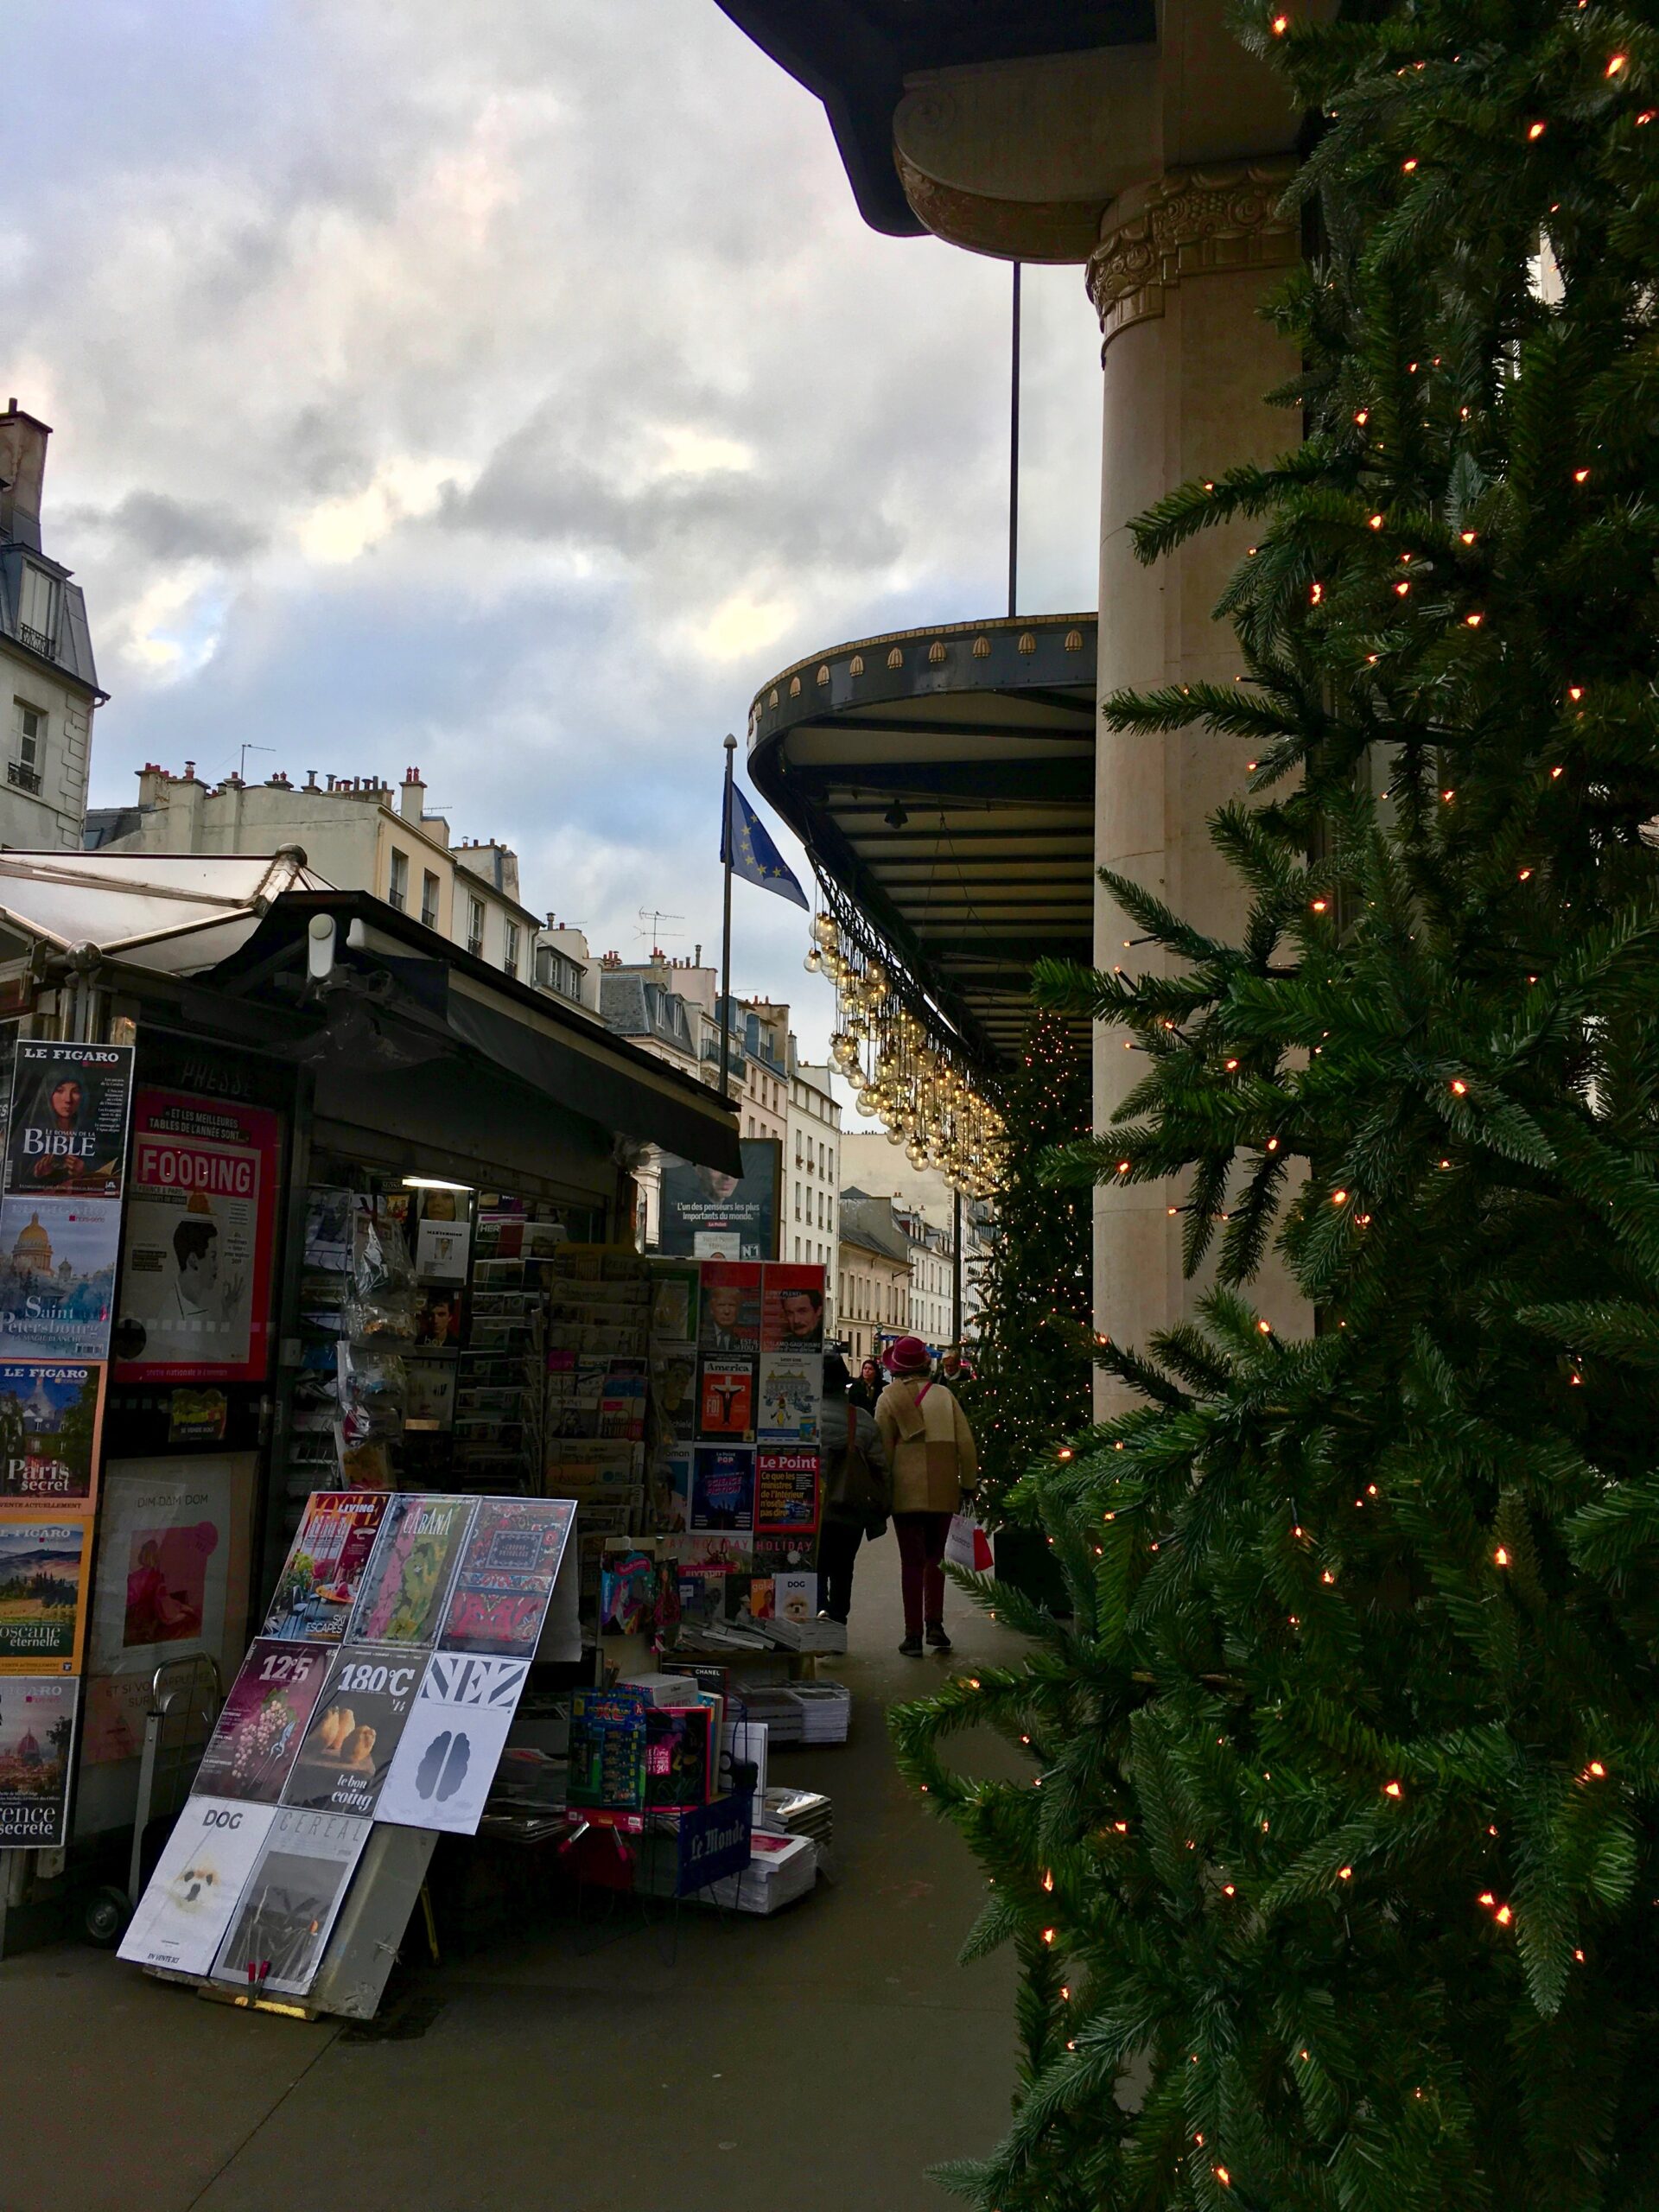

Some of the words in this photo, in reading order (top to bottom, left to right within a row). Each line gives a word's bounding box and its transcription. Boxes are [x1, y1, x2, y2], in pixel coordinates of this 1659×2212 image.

[24, 1048, 48, 1058] LE
[53, 1050, 119, 1063] FIGARO
[149, 1117, 180, 1132] TABLES
[181, 1122, 190, 1133] DE
[171, 1109, 181, 1119] ET
[181, 1110, 194, 1122] LES
[196, 1112, 238, 1128] MEILLEURES
[23, 1128, 97, 1158] BIBLE
[677, 1202, 690, 1211] L'un
[691, 1203, 703, 1211] des
[704, 1204, 734, 1214] penseurs
[734, 1203, 745, 1211] les
[746, 1203, 760, 1214] plus
[25, 1295, 73, 1319] Saint
[4, 1368, 24, 1377] LE
[29, 1369, 88, 1379] FIGARO
[166, 1369, 196, 1377] nationale
[707, 1363, 749, 1372] America
[760, 1456, 775, 1469] Le
[779, 1455, 817, 1469] Point
[7, 1459, 69, 1481] Paris
[761, 1471, 771, 1480] Ce
[772, 1473, 783, 1482] que
[784, 1471, 796, 1480] les
[22, 1479, 69, 1492] secret
[761, 1481, 793, 1490] ministres
[185, 1494, 208, 1505] DOM
[760, 1491, 771, 1499] de
[338, 1503, 376, 1513] LIVING
[760, 1509, 772, 1517] pas
[404, 1507, 453, 1535] CABANA
[756, 1540, 812, 1552] HOLIDAY
[333, 1615, 346, 1625] SKI
[306, 1622, 343, 1634] ESCAPES
[338, 1663, 416, 1697] 180°C
[421, 1657, 526, 1707] NEZ
[337, 1774, 346, 1786] le
[347, 1775, 367, 1789] bon
[331, 1788, 373, 1812] coing
[202, 1809, 244, 1829] DOG
[279, 1811, 362, 1841] CEREAL
[690, 1834, 704, 1863] Le
[704, 1818, 746, 1857] Monde
[156, 1954, 171, 1962] VENTE
